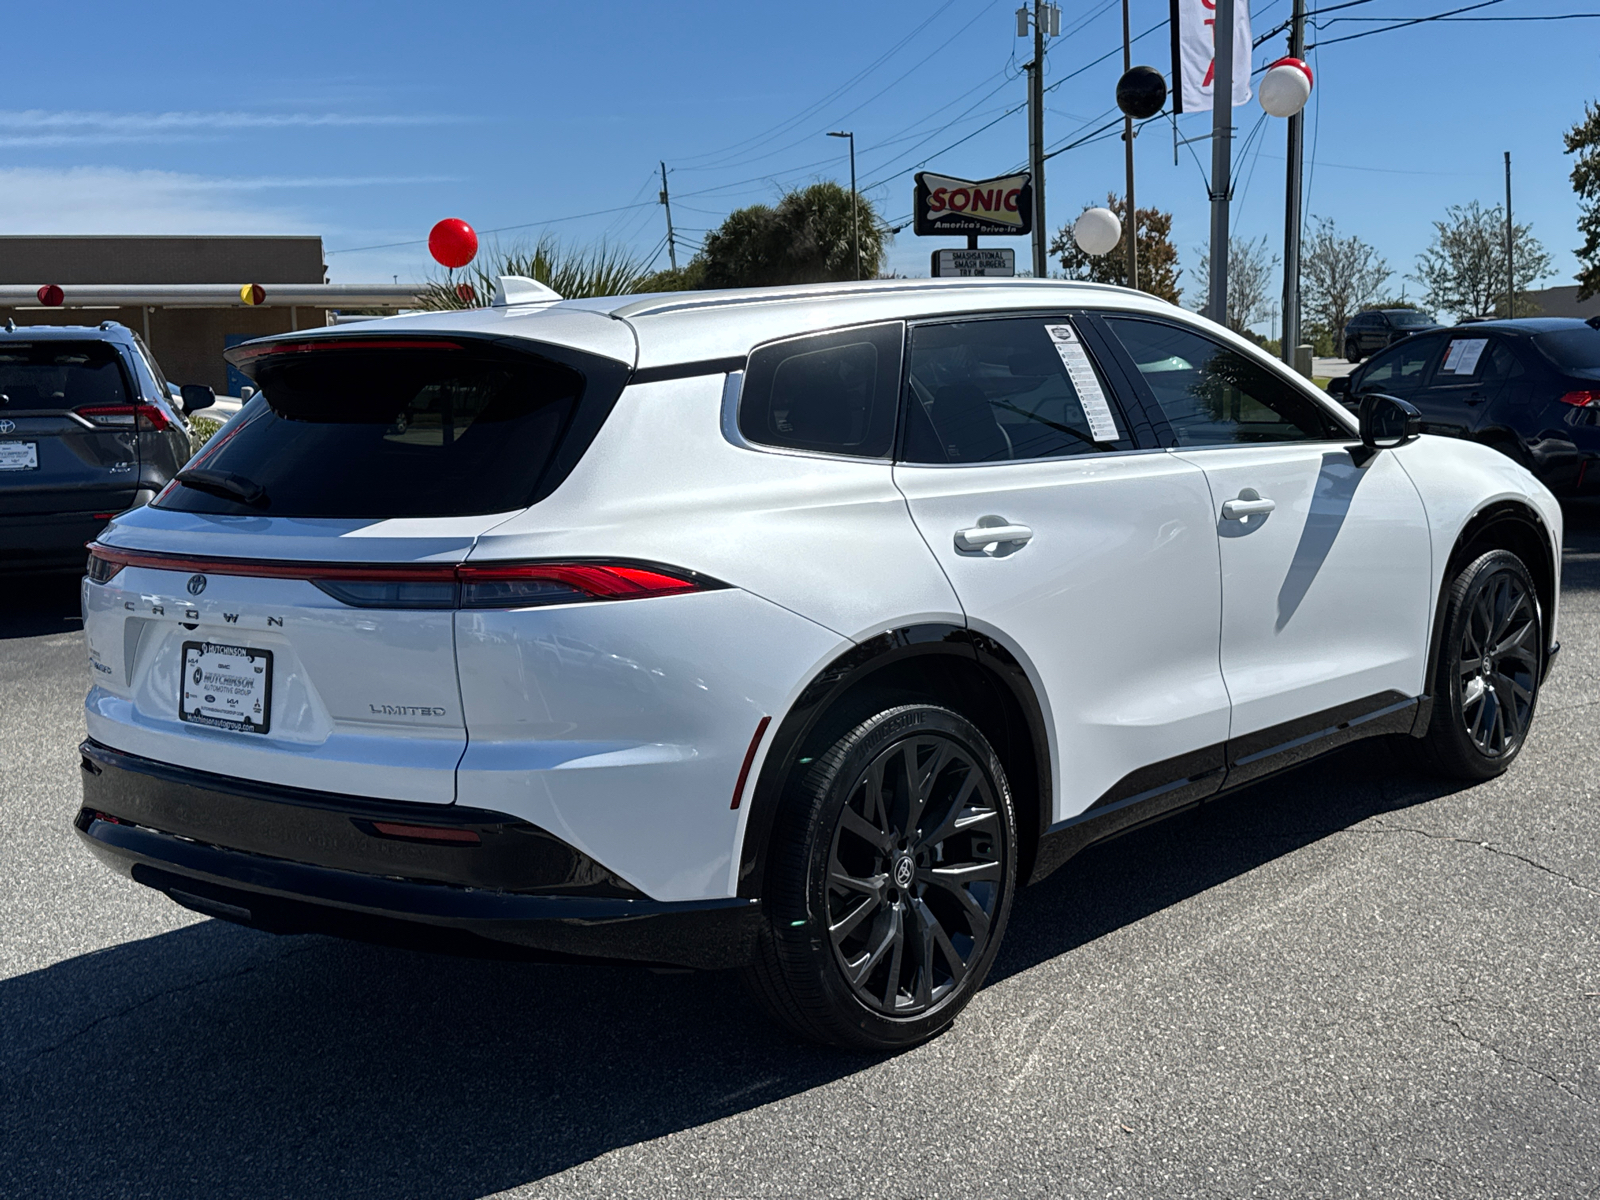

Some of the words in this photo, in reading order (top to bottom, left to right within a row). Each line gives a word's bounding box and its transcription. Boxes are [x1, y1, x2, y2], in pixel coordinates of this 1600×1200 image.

[931, 187, 1021, 212] SONIC
[934, 221, 980, 229] America's
[952, 252, 1003, 260] SMASHSATIONAL
[954, 260, 976, 268] SMASH
[979, 260, 1006, 268] BURGERS
[124, 601, 284, 627] CROWN
[208, 645, 247, 657] HUTCHINSON
[203, 674, 255, 689] HUTCHINSON
[204, 684, 233, 694] AUTOMOTIVE
[234, 688, 251, 696] GROUP
[369, 704, 446, 716] LIMITED
[855, 712, 927, 761] BRIDGESTONE
